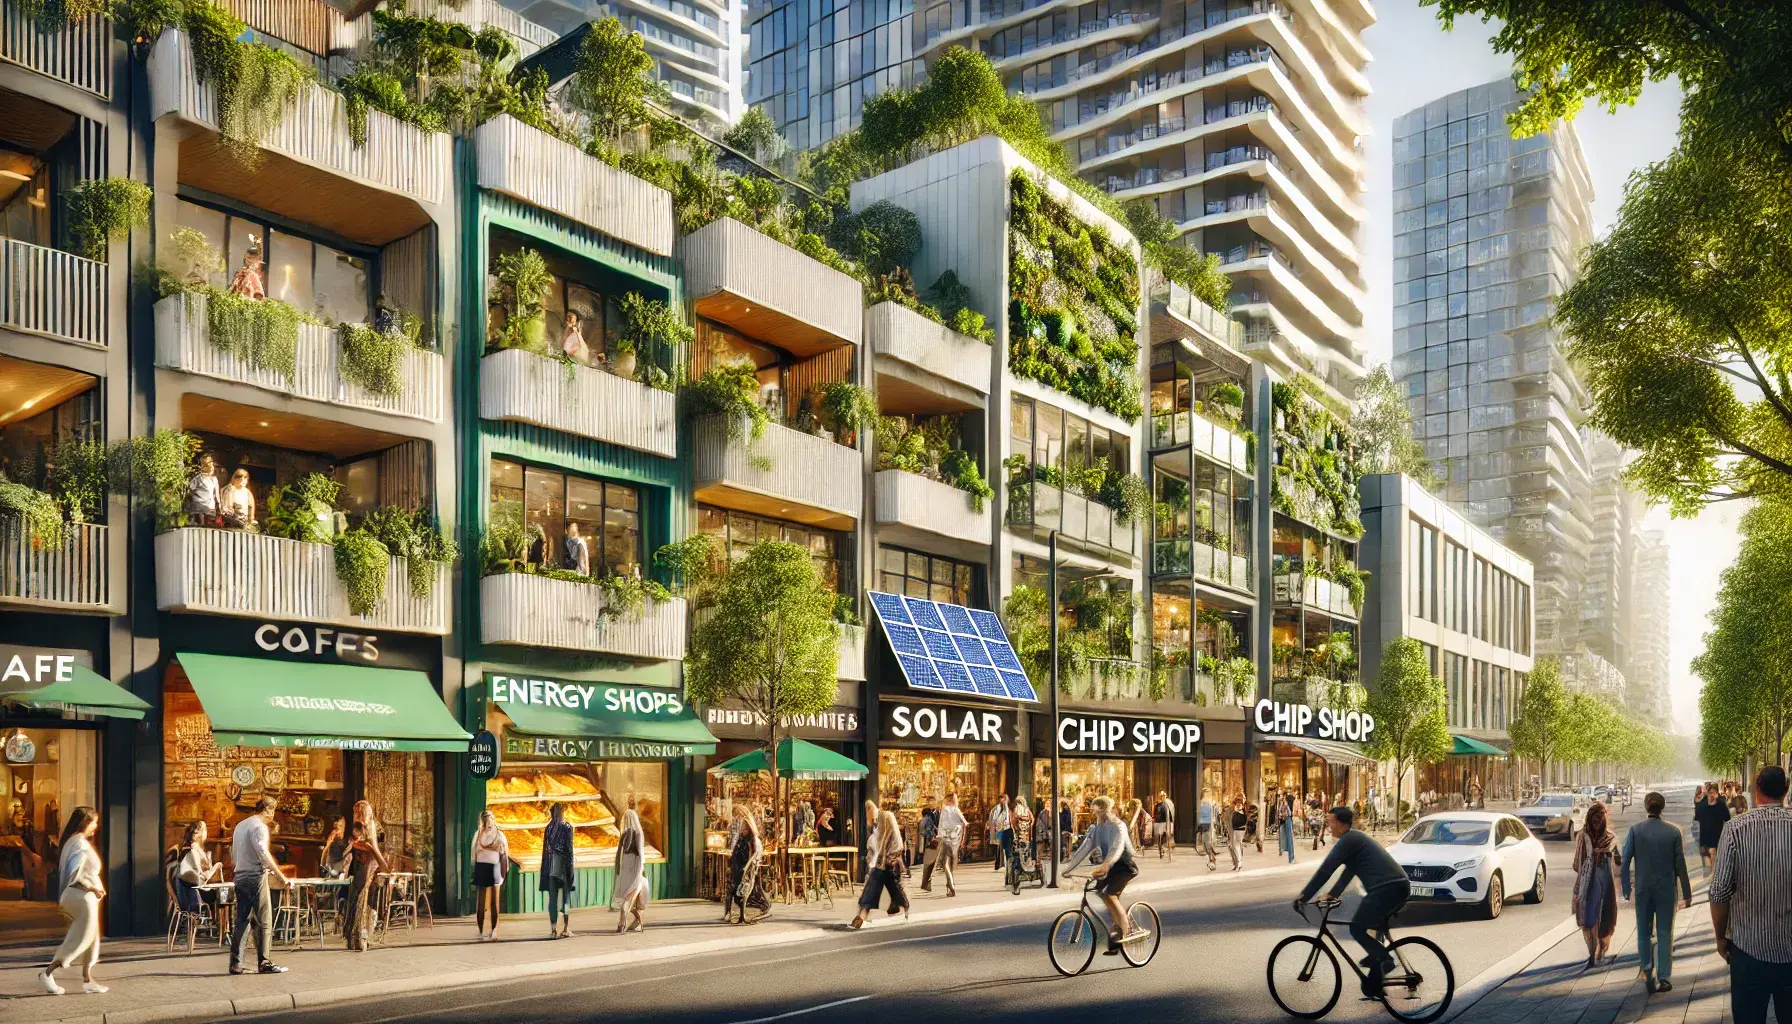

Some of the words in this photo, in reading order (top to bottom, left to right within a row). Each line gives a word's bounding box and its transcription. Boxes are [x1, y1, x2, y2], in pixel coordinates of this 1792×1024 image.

[1, 654, 75, 682] AFE
[492, 676, 595, 709] ENERGY
[604, 687, 684, 714] SHOPS
[891, 705, 1003, 743] SOLAR
[1058, 717, 1125, 752] CHIP
[1132, 721, 1201, 753] SHOP
[1254, 698, 1313, 735] CHIP
[1318, 706, 1375, 742] SHOP
